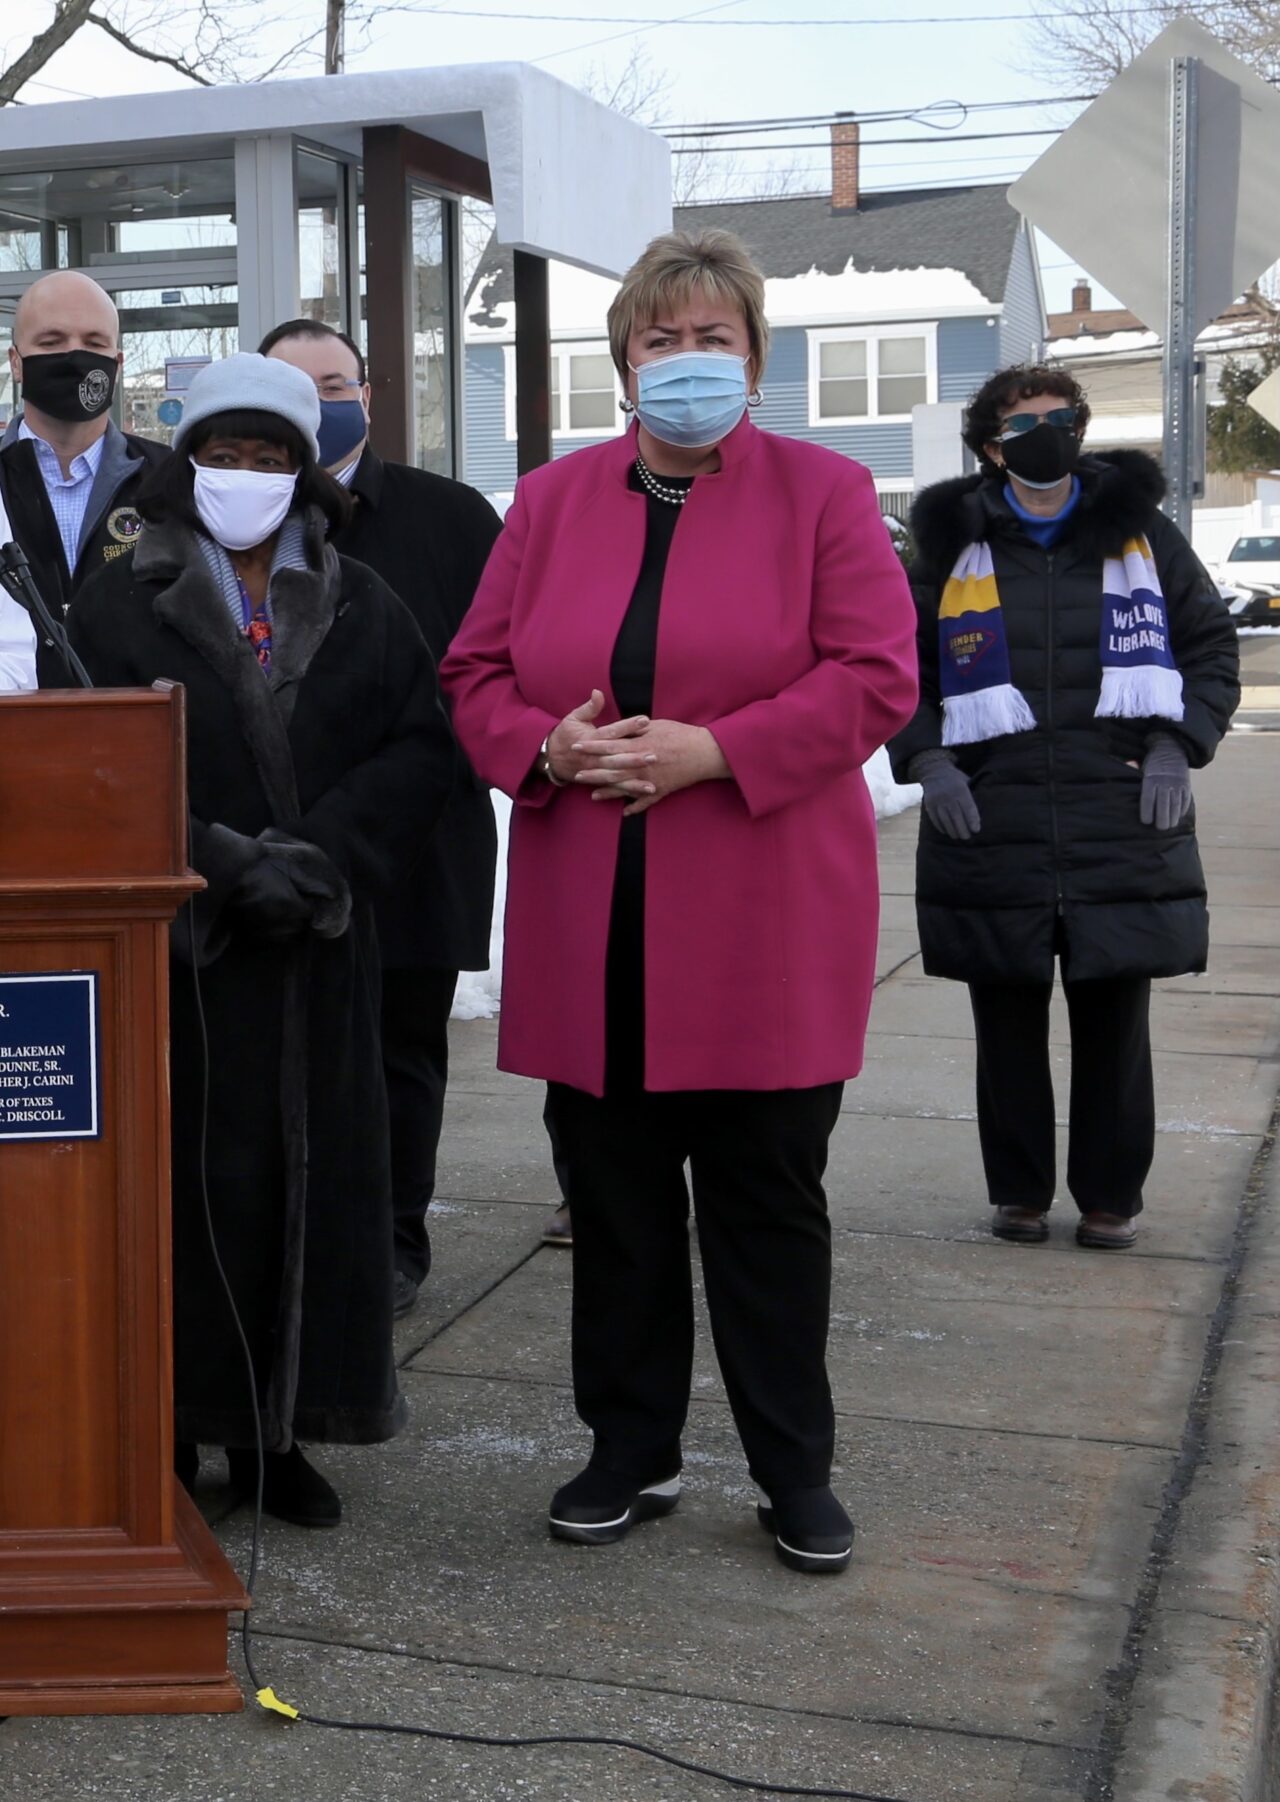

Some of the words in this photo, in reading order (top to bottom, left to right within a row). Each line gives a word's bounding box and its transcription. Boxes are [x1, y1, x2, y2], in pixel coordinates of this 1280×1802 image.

[0, 1045, 66, 1058] BLAKEMAN
[44, 1060, 62, 1072] SR.
[22, 1076, 32, 1089] J.
[33, 1075, 74, 1087] CARINI
[6, 1098, 20, 1108] OF
[21, 1096, 53, 1107] TAXES
[7, 1110, 65, 1122] DRISCOLL
